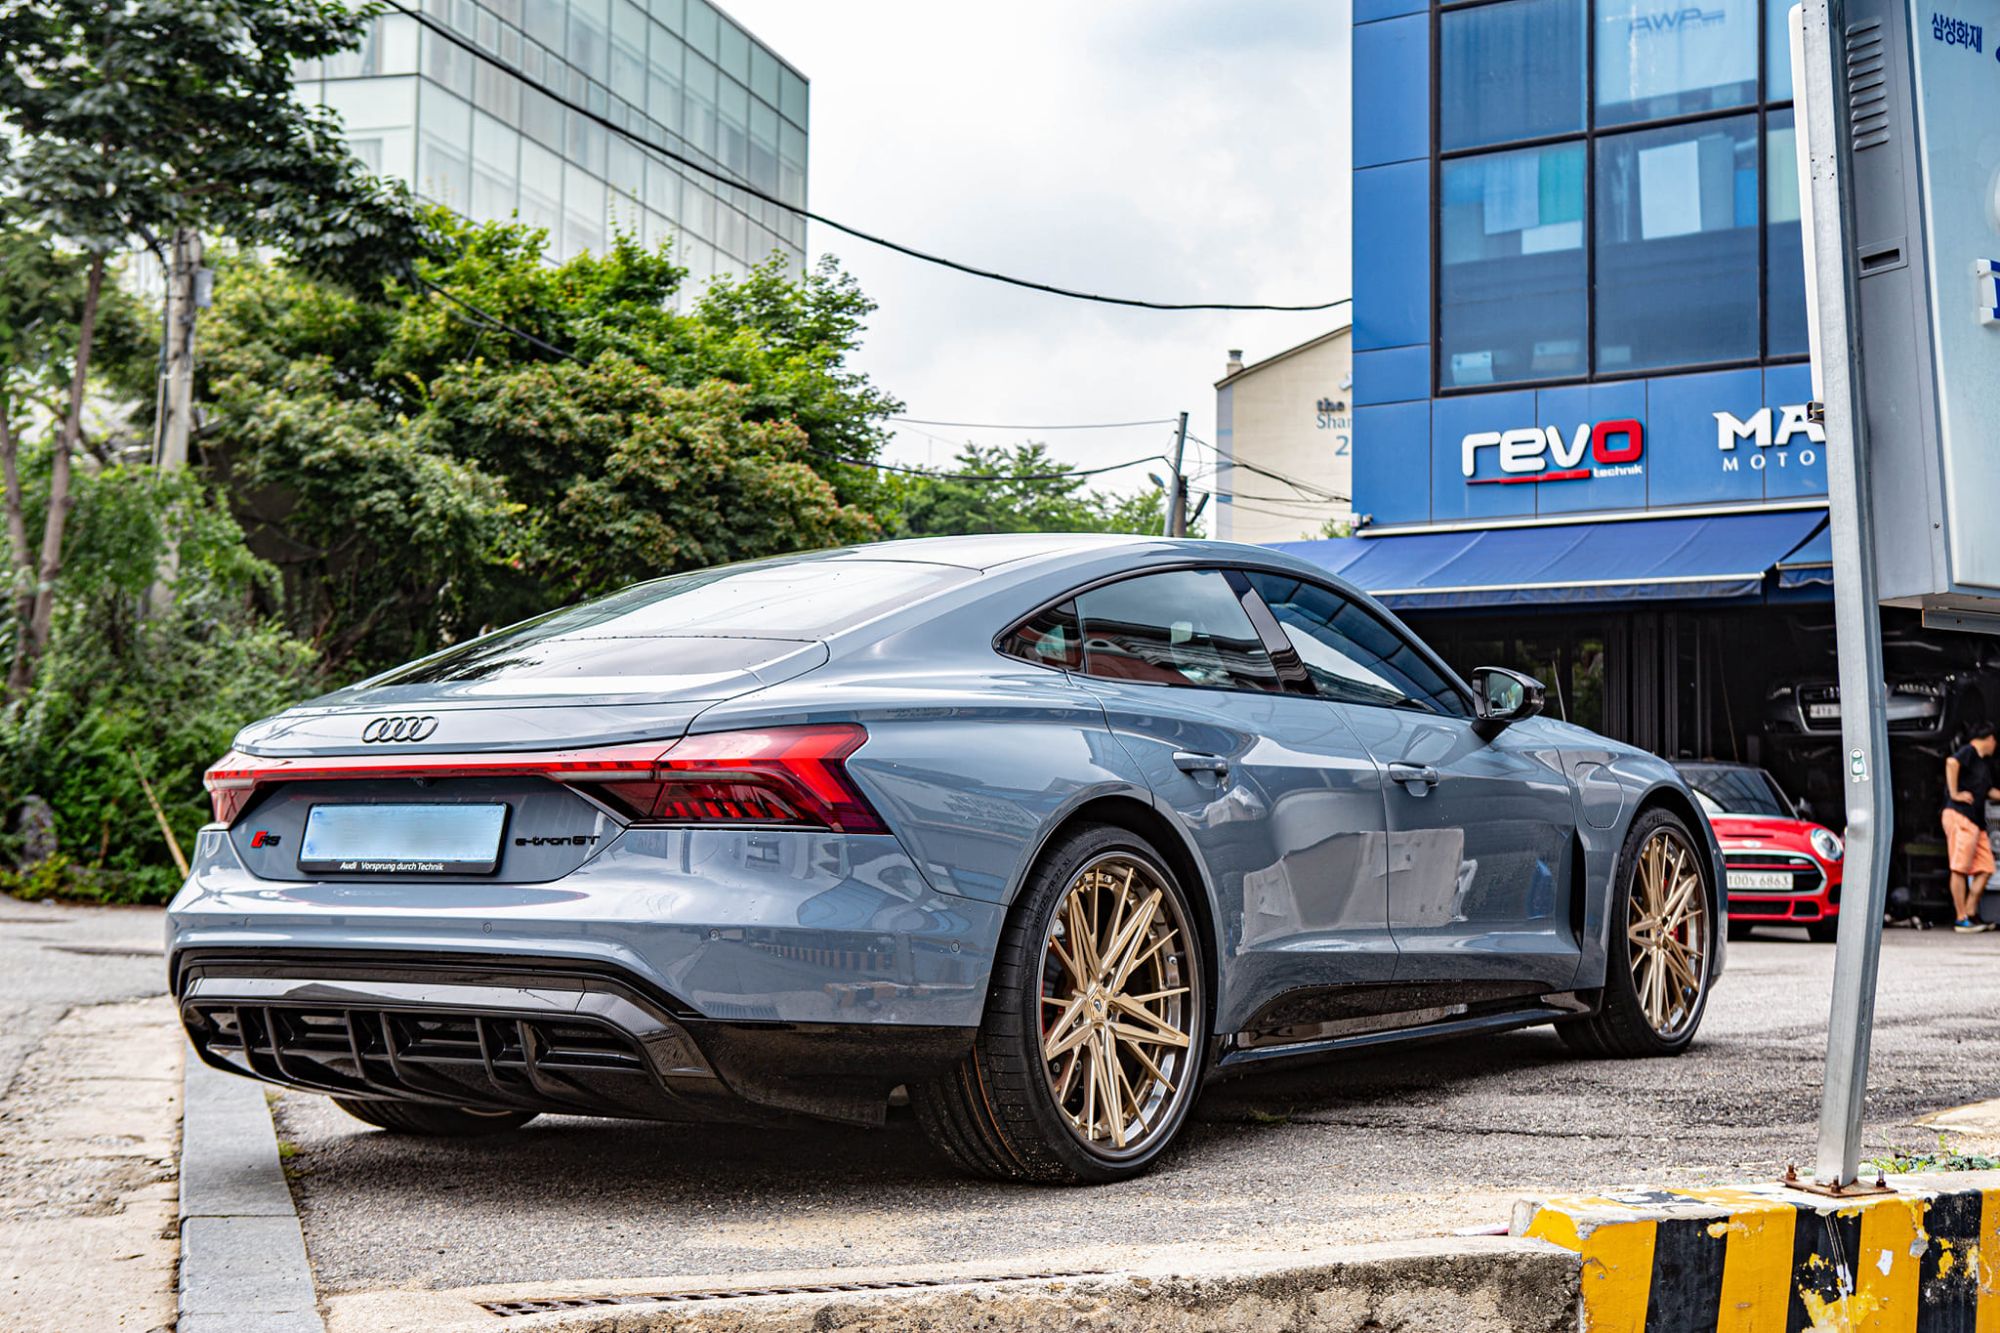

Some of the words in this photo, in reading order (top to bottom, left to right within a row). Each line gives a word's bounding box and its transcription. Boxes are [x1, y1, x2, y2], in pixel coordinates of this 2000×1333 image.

[1931, 12, 1982, 54] 삼성화재
[1317, 397, 1345, 412] the
[1462, 418, 1642, 477] revo
[1593, 464, 1643, 478] technik
[340, 861, 357, 870] Audi
[360, 861, 396, 872] Vorsprung
[396, 861, 416, 870] durch
[417, 862, 444, 871] Technik
